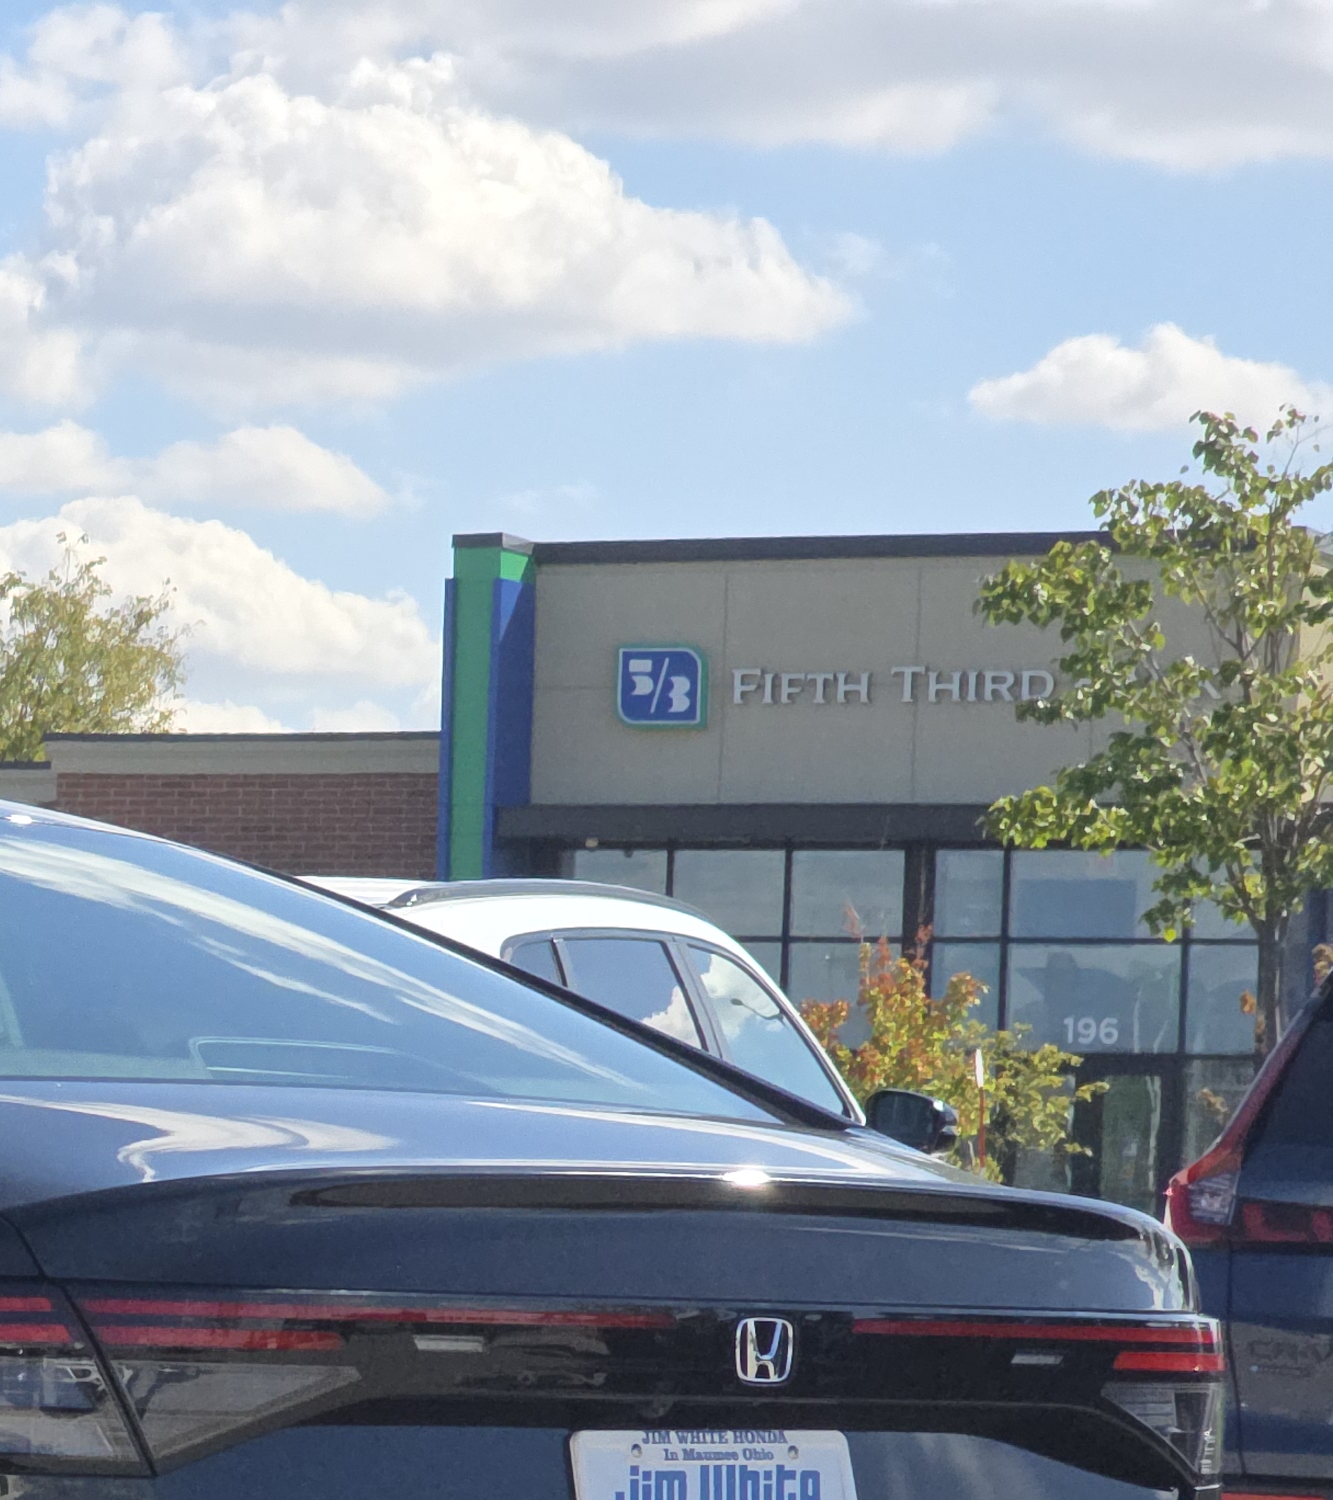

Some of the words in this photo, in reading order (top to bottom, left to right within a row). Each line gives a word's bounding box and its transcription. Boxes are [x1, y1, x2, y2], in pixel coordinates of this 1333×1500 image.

[731, 668, 870, 704] FIFTH
[890, 665, 1056, 703] THIRD
[1063, 1016, 1119, 1045] 196
[641, 1430, 673, 1445] JIM
[674, 1430, 729, 1445] WHITE
[732, 1430, 789, 1445] HONDA
